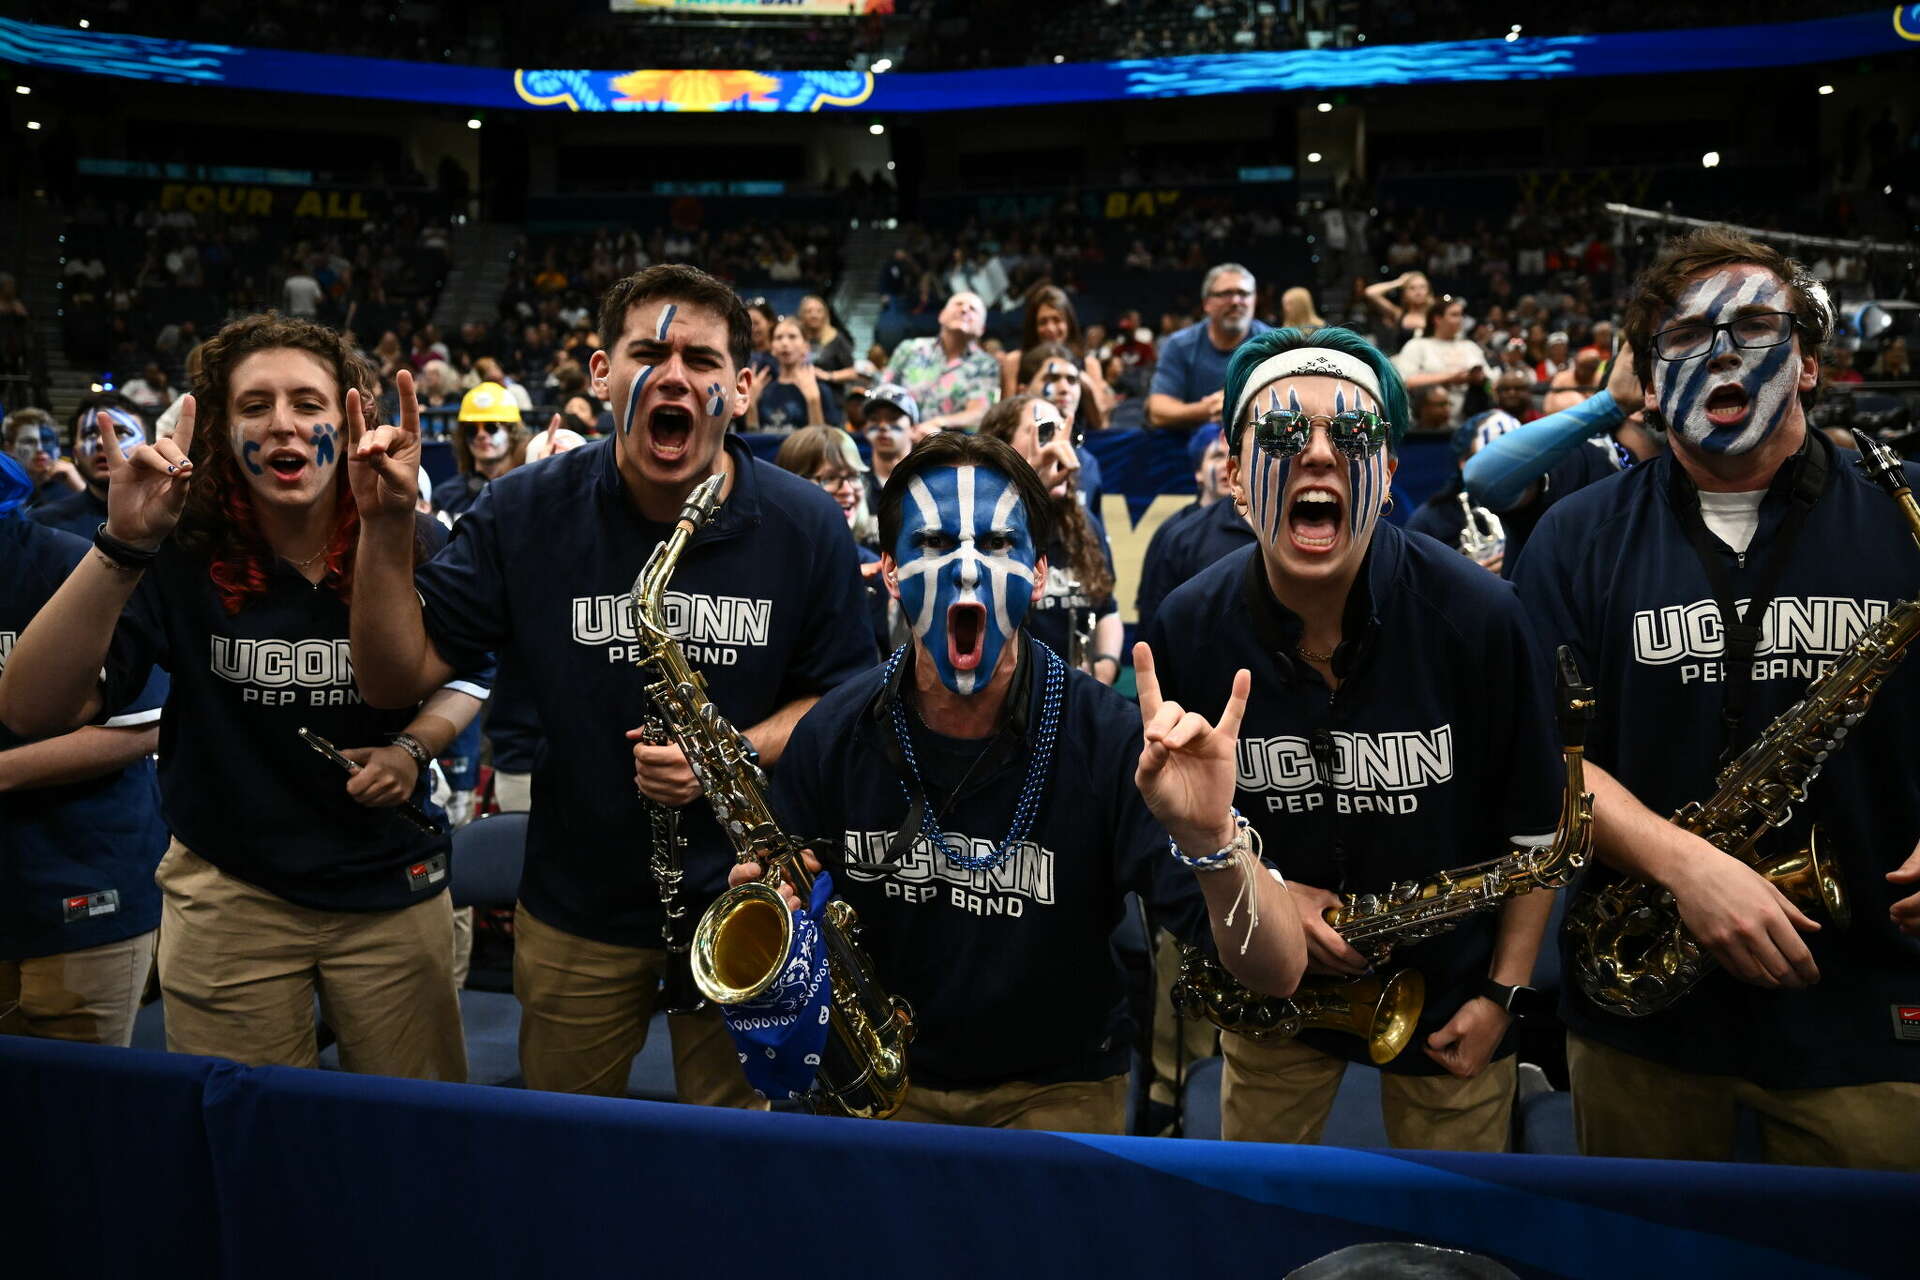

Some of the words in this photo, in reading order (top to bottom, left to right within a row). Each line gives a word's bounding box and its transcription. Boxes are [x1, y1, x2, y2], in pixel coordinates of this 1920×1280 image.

[608, 645, 641, 664] PE
[680, 643, 738, 666] AND
[243, 687, 296, 706] PEP
[310, 688, 362, 706] BAN
[1266, 793, 1324, 814] PEP
[1337, 793, 1418, 815] BAND
[885, 882, 938, 903] PEP
[951, 887, 1023, 918] BAND
